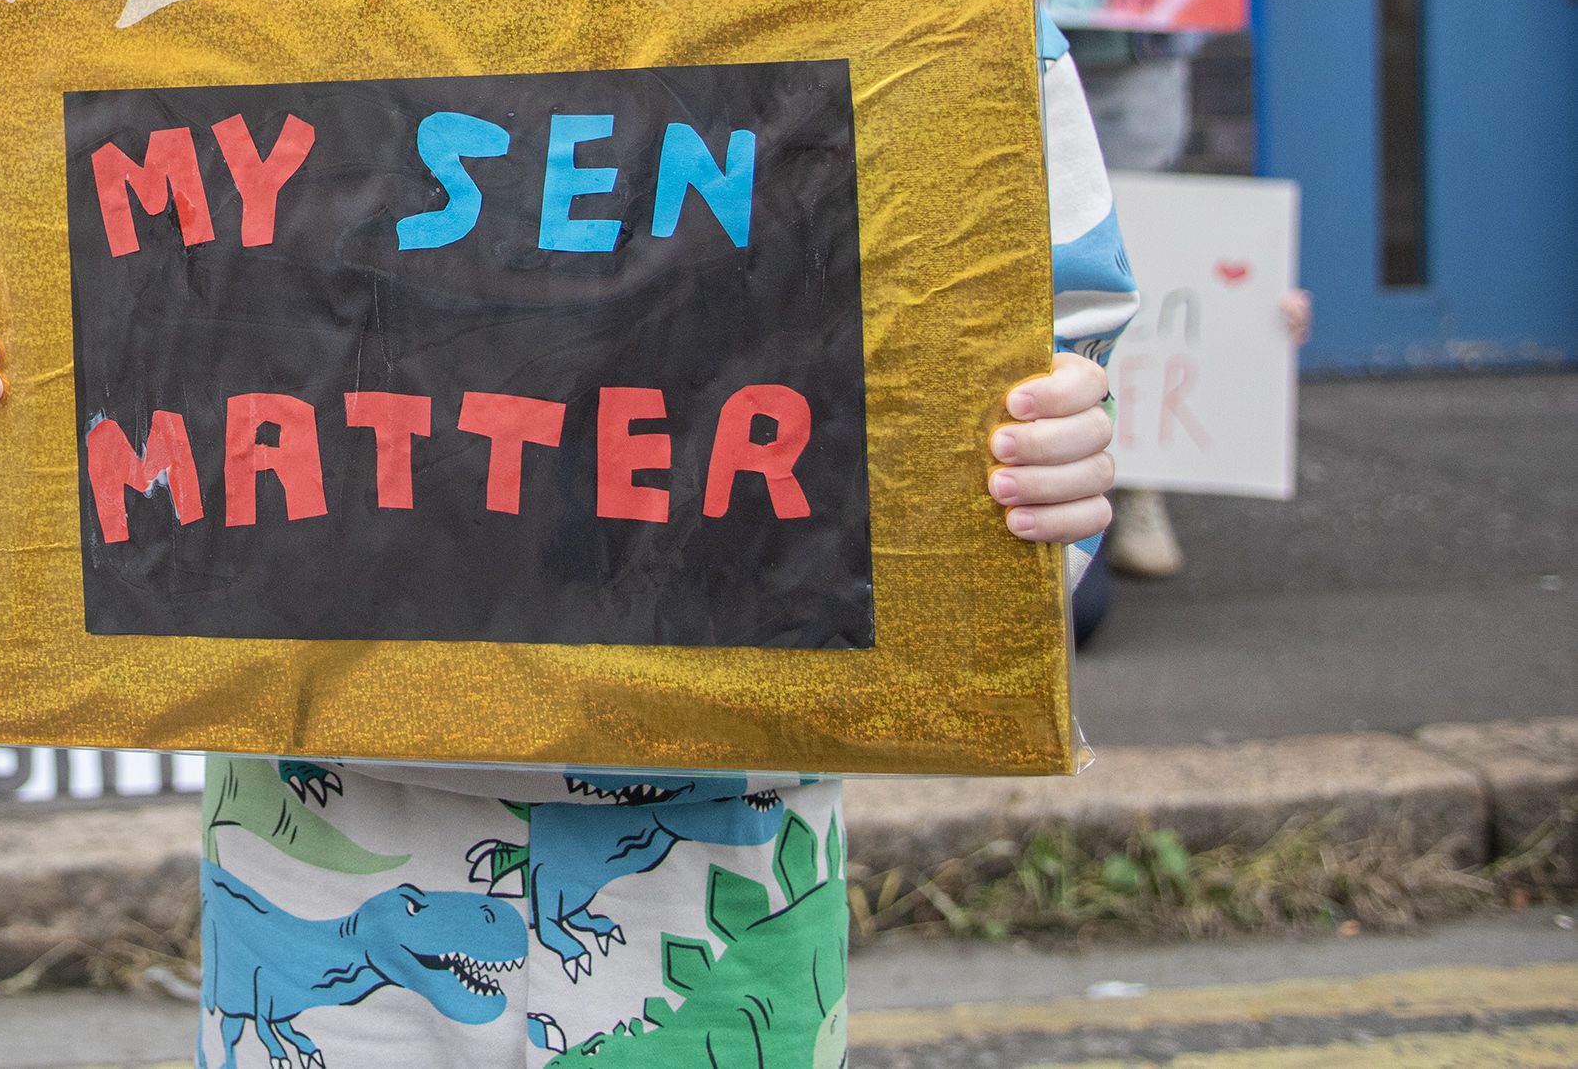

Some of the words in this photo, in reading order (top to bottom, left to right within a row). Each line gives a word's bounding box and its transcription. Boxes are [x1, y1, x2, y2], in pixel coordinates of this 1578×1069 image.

[90, 112, 316, 258] MY
[395, 110, 757, 253] SEN
[84, 383, 813, 544] MATTER
